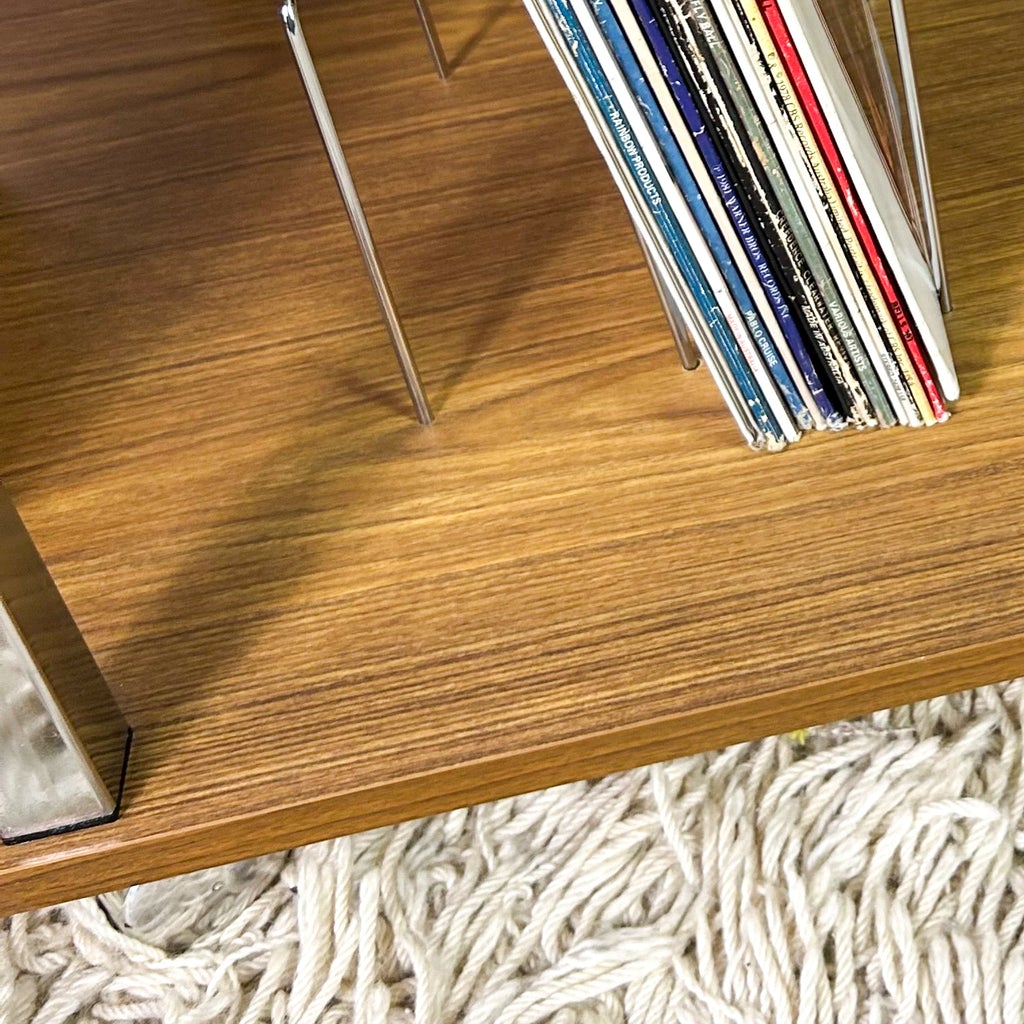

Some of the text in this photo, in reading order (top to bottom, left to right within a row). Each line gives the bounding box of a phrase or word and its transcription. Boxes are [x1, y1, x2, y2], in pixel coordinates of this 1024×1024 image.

[700, 21, 719, 48] BALL
[609, 111, 662, 205] RAINBOW PRODUCTS
[726, 195, 750, 234] WARNER
[758, 263, 783, 303] RECORDS
[743, 309, 778, 367] PABLO CRUISE
[828, 300, 867, 372] VARIOUS ARTISTS
